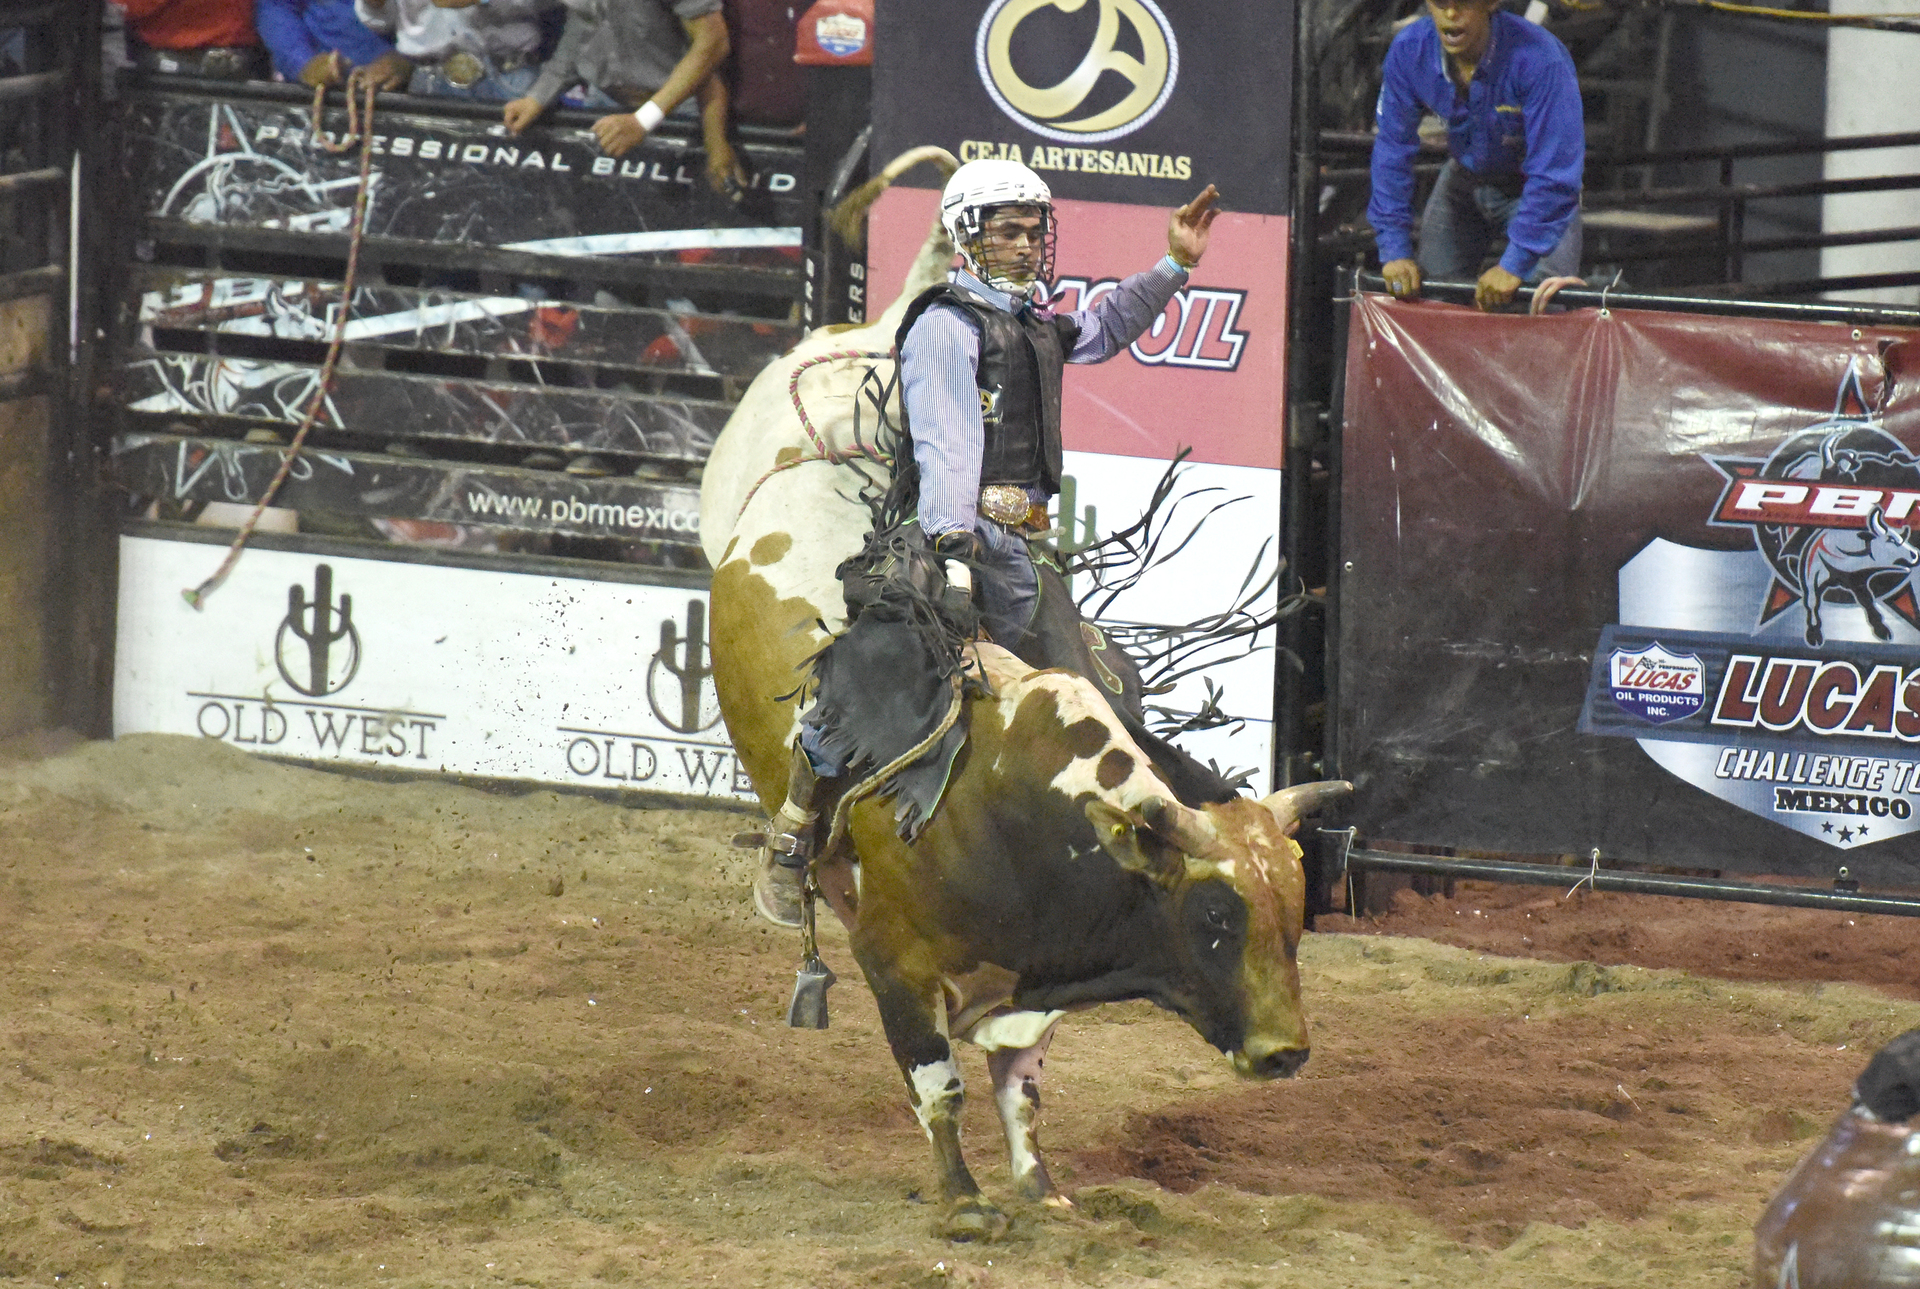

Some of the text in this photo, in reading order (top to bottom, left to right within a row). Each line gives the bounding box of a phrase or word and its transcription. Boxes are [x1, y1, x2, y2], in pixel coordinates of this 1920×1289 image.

[592, 156, 694, 184] BULL
[959, 139, 1193, 180] CEJA ARTESANIAS
[1620, 668, 1697, 691] LUCAS
[1616, 691, 1699, 706] OIL PRODUCTS
[1647, 706, 1670, 716] INC.
[197, 701, 437, 759] OLD WEST
[566, 736, 658, 782] OLD
[1714, 746, 1890, 792] CHALLENGE
[1774, 787, 1913, 820] MEXICO
